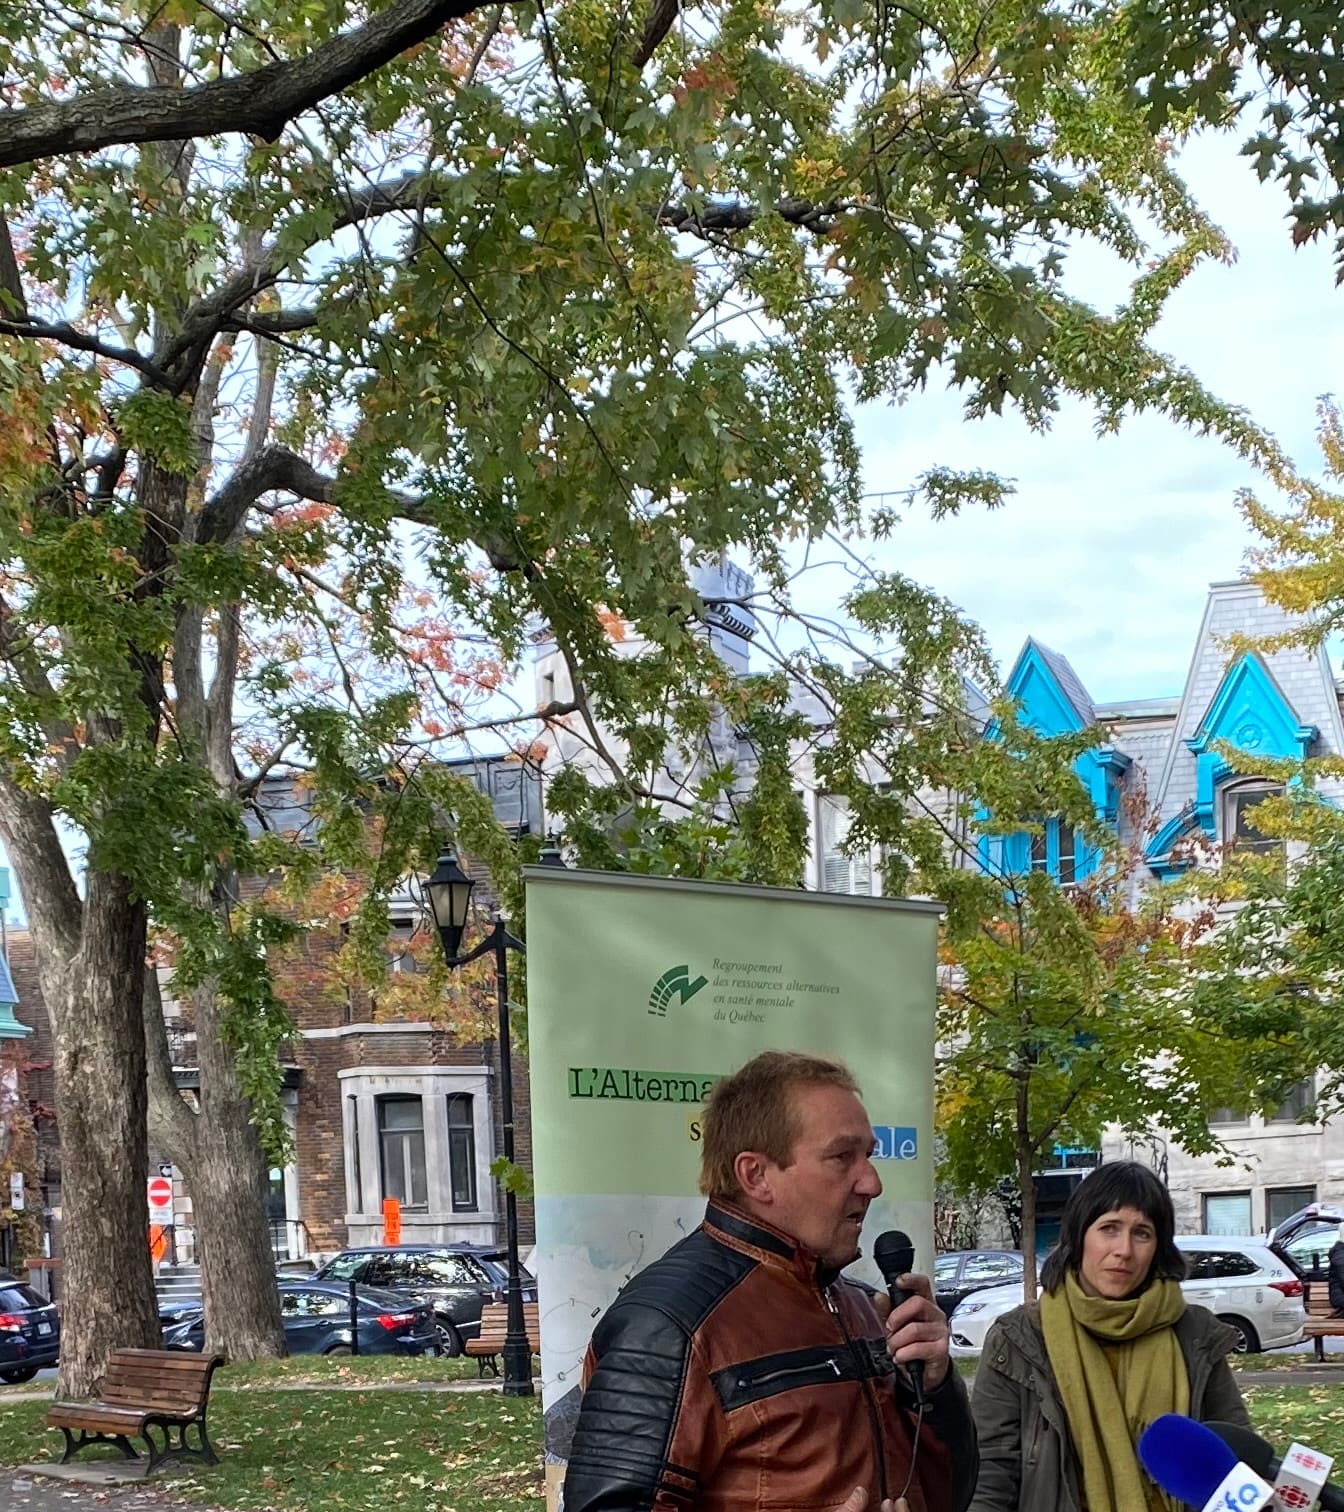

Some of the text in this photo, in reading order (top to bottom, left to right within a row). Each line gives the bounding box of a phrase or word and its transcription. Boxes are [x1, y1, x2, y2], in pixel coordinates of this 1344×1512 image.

[712, 958, 782, 974] Regroupement
[713, 977, 840, 994] des ressources alternatives
[727, 994, 754, 1005] santé
[756, 996, 794, 1008] mentale
[714, 1010, 766, 1024] du Québec
[570, 1068, 713, 1103] L'Alterna
